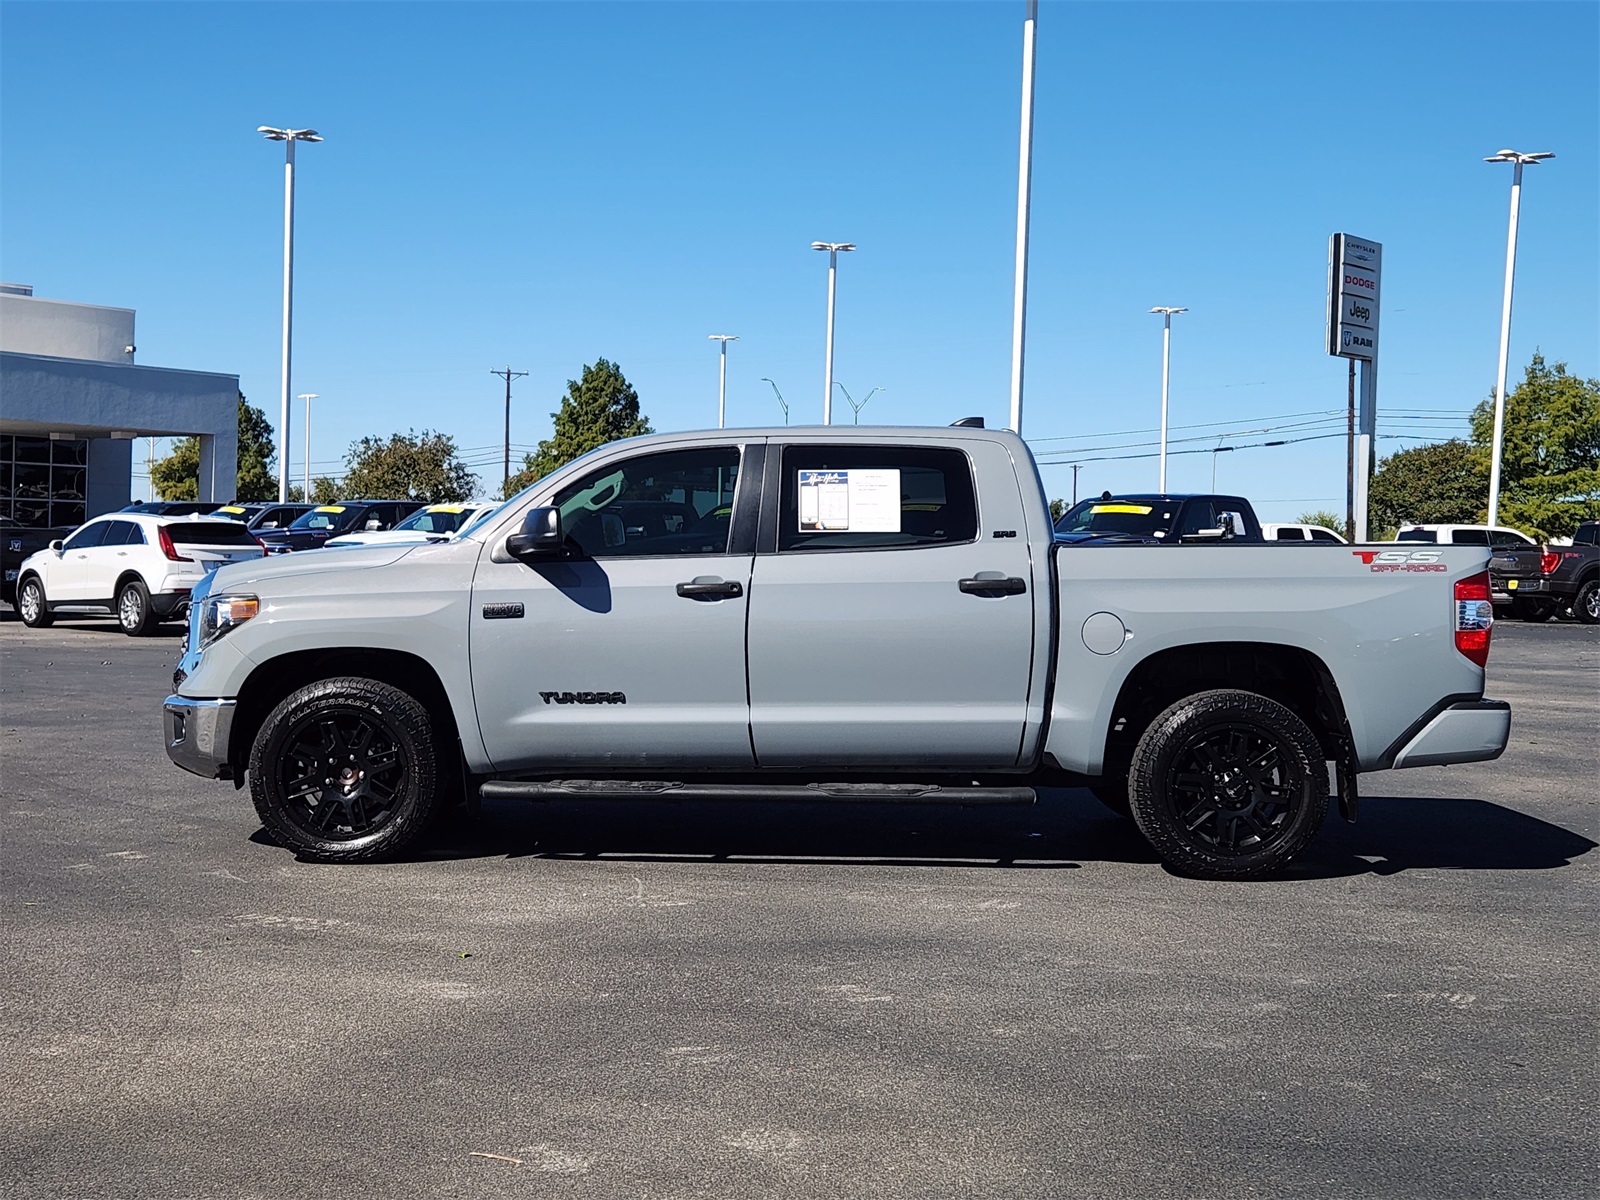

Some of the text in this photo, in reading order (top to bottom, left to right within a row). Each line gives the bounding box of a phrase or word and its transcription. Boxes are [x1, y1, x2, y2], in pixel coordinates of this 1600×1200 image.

[1346, 242, 1376, 254] CHRYSLER
[1345, 275, 1375, 290] DODGE
[1349, 301, 1370, 323] Jeep
[1352, 336, 1373, 348] RAM
[1370, 564, 1448, 573] OFF-ROAD
[538, 691, 627, 705] TUNDRA
